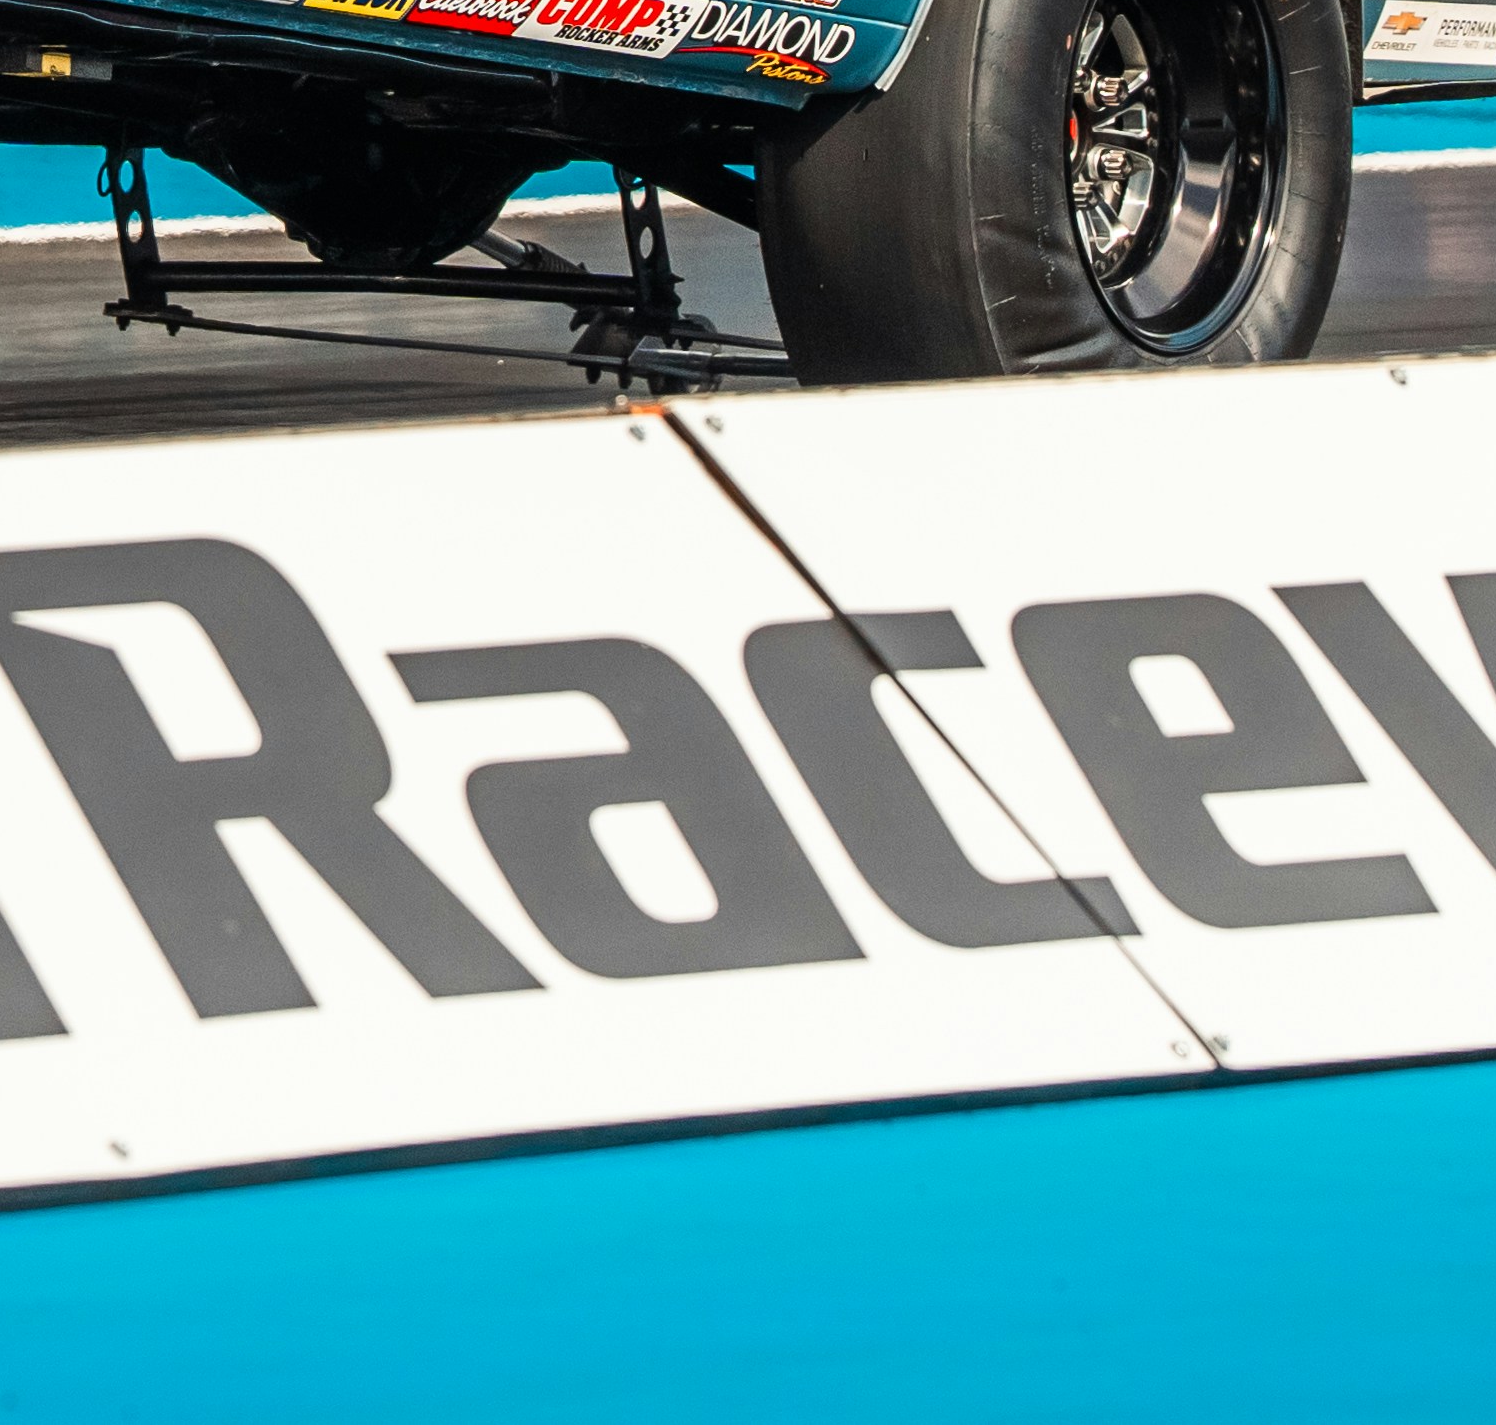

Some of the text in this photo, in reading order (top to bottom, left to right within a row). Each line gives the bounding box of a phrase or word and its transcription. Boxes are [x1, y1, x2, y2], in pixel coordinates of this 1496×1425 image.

[554, 24, 666, 52] ROCKER ARMS
[691, 0, 856, 65] DIAMOND
[1370, 41, 1417, 52] CHEVROLET
[746, 53, 827, 85] Pistons
